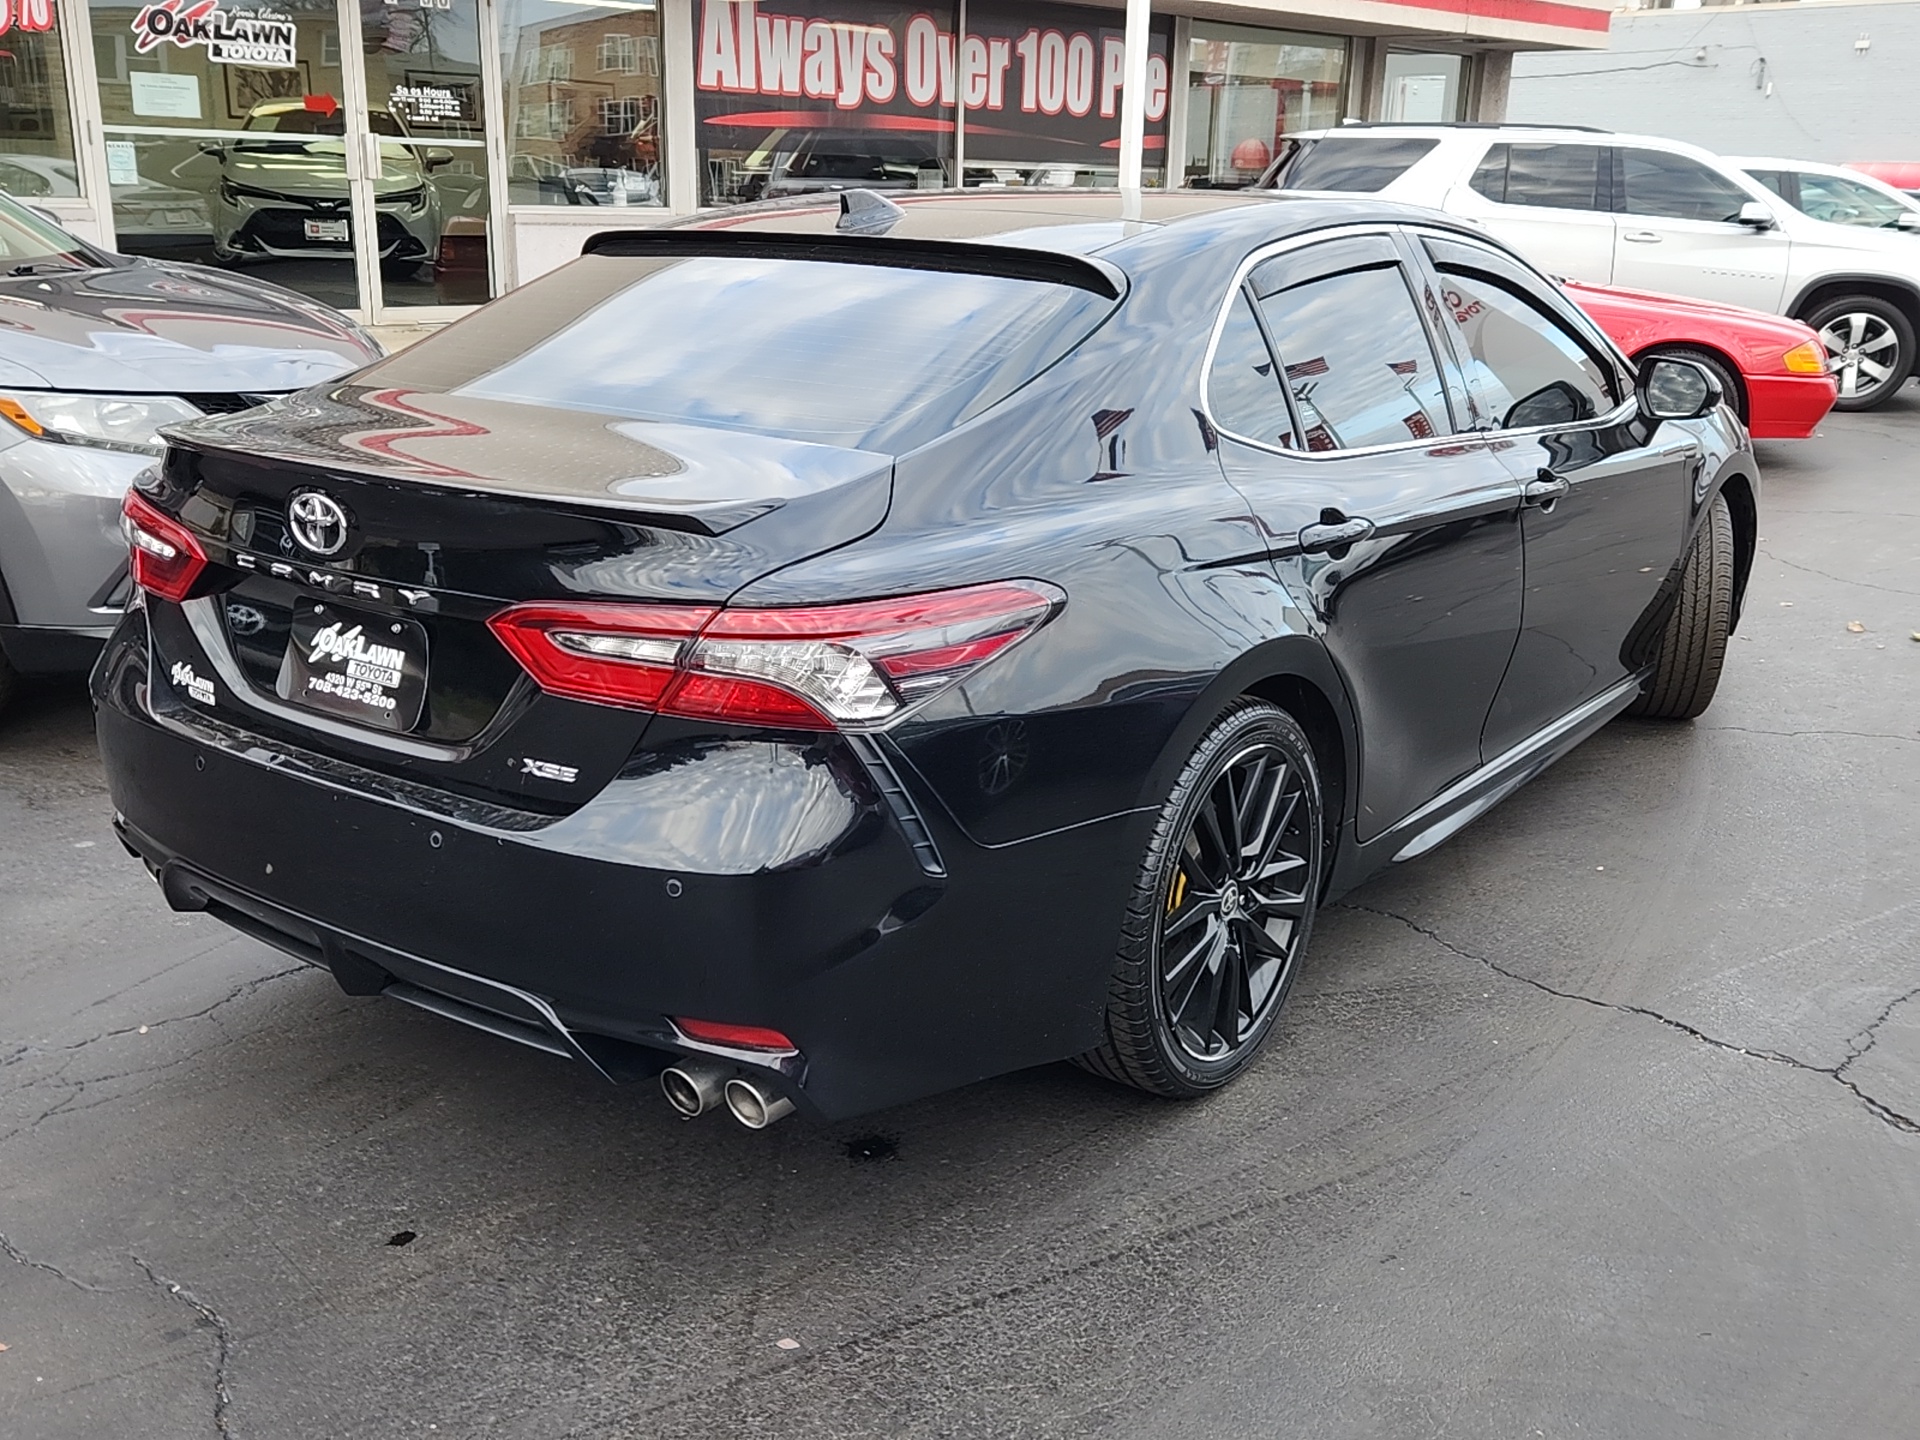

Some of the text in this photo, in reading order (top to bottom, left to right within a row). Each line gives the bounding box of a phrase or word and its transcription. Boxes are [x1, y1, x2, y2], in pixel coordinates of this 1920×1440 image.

[219, 44, 288, 62] TOYOTA
[698, 0, 1168, 121] Always Over 100 Pe
[325, 672, 345, 684] 4320
[346, 677, 356, 688] W
[353, 662, 394, 684] TOYOTA
[308, 676, 397, 709] 708-423-5200
[520, 758, 579, 783] XSE
